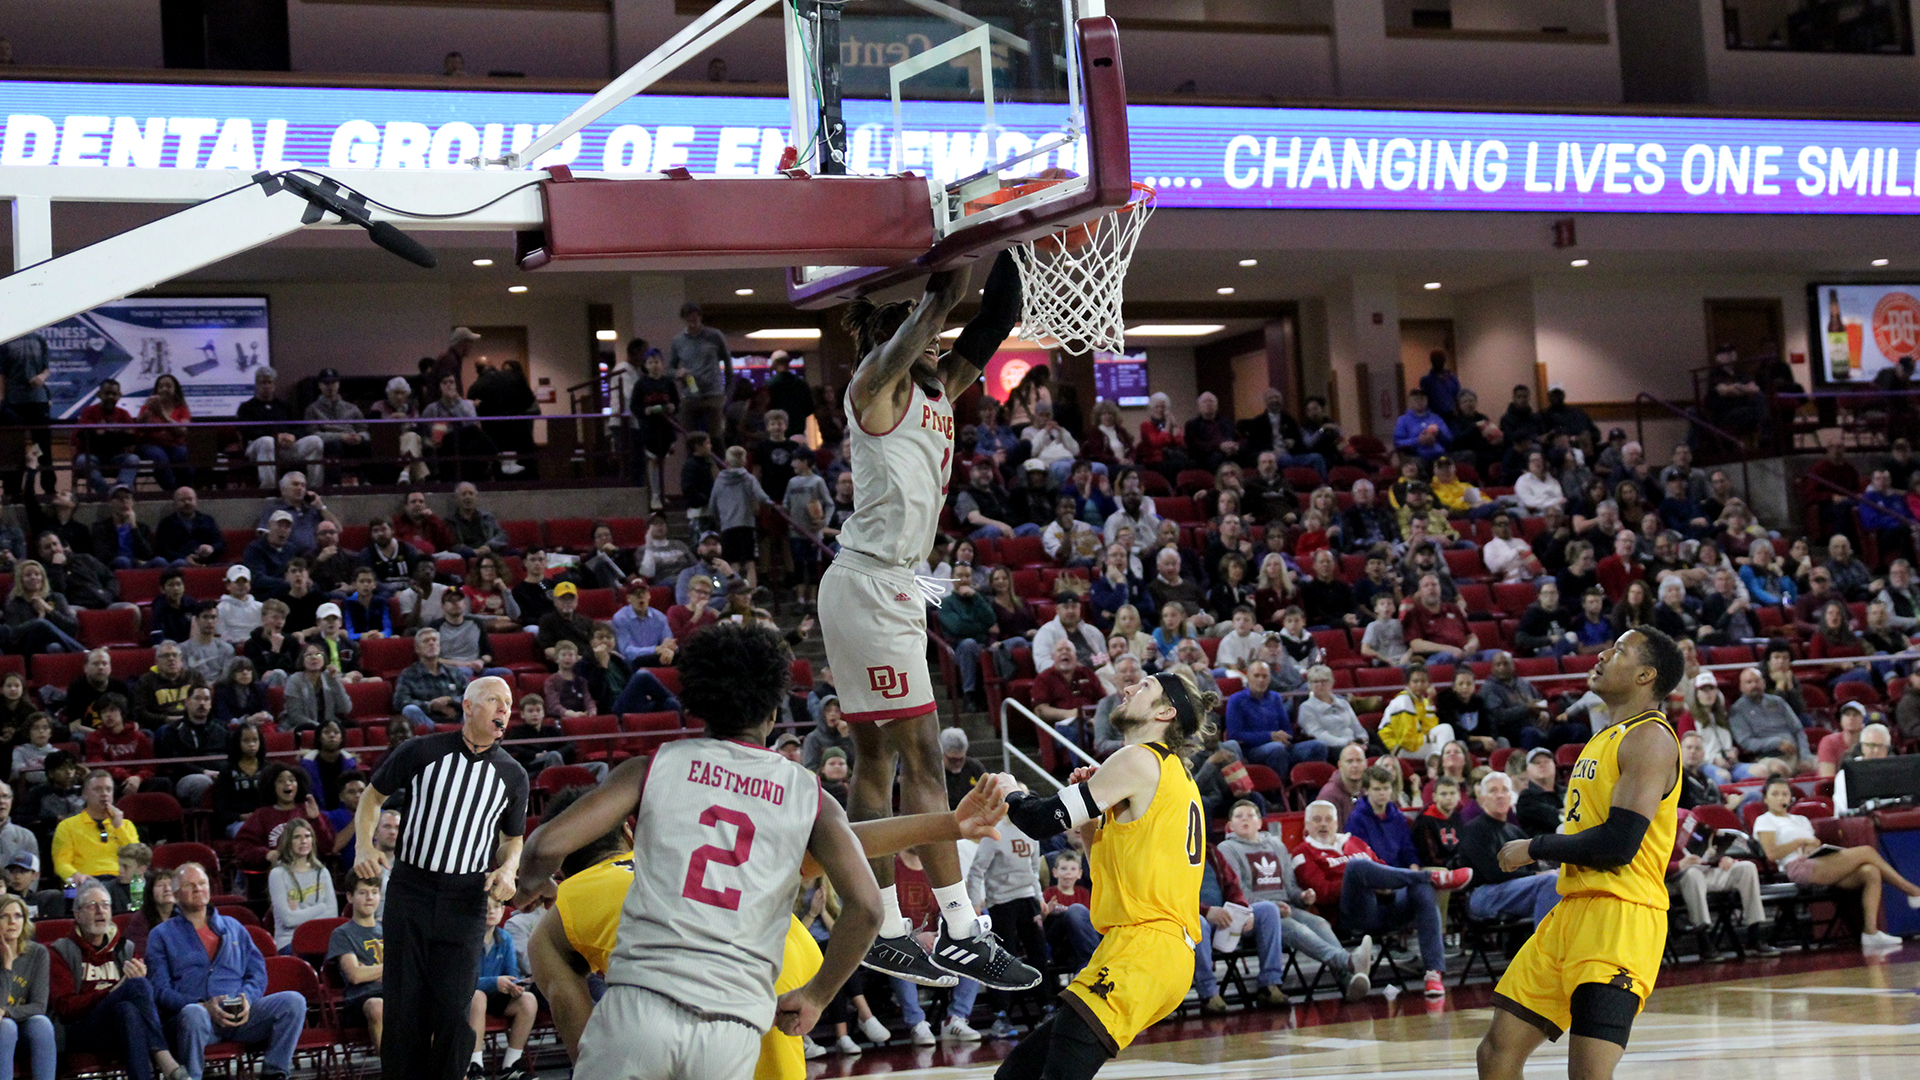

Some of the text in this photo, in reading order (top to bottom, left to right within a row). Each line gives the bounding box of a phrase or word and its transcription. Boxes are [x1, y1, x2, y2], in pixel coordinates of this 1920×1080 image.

[0, 115, 302, 170] DENTAL
[329, 119, 582, 171] GROUP
[602, 124, 695, 173] OF
[1223, 134, 1509, 192] CHANGING
[1524, 140, 1667, 195] LIVES
[1681, 143, 1783, 195] ONE
[1796, 145, 1920, 197] SMIL
[35, 327, 88, 338] ITNESS
[687, 760, 785, 806] EASTMOND
[682, 804, 756, 911] 2
